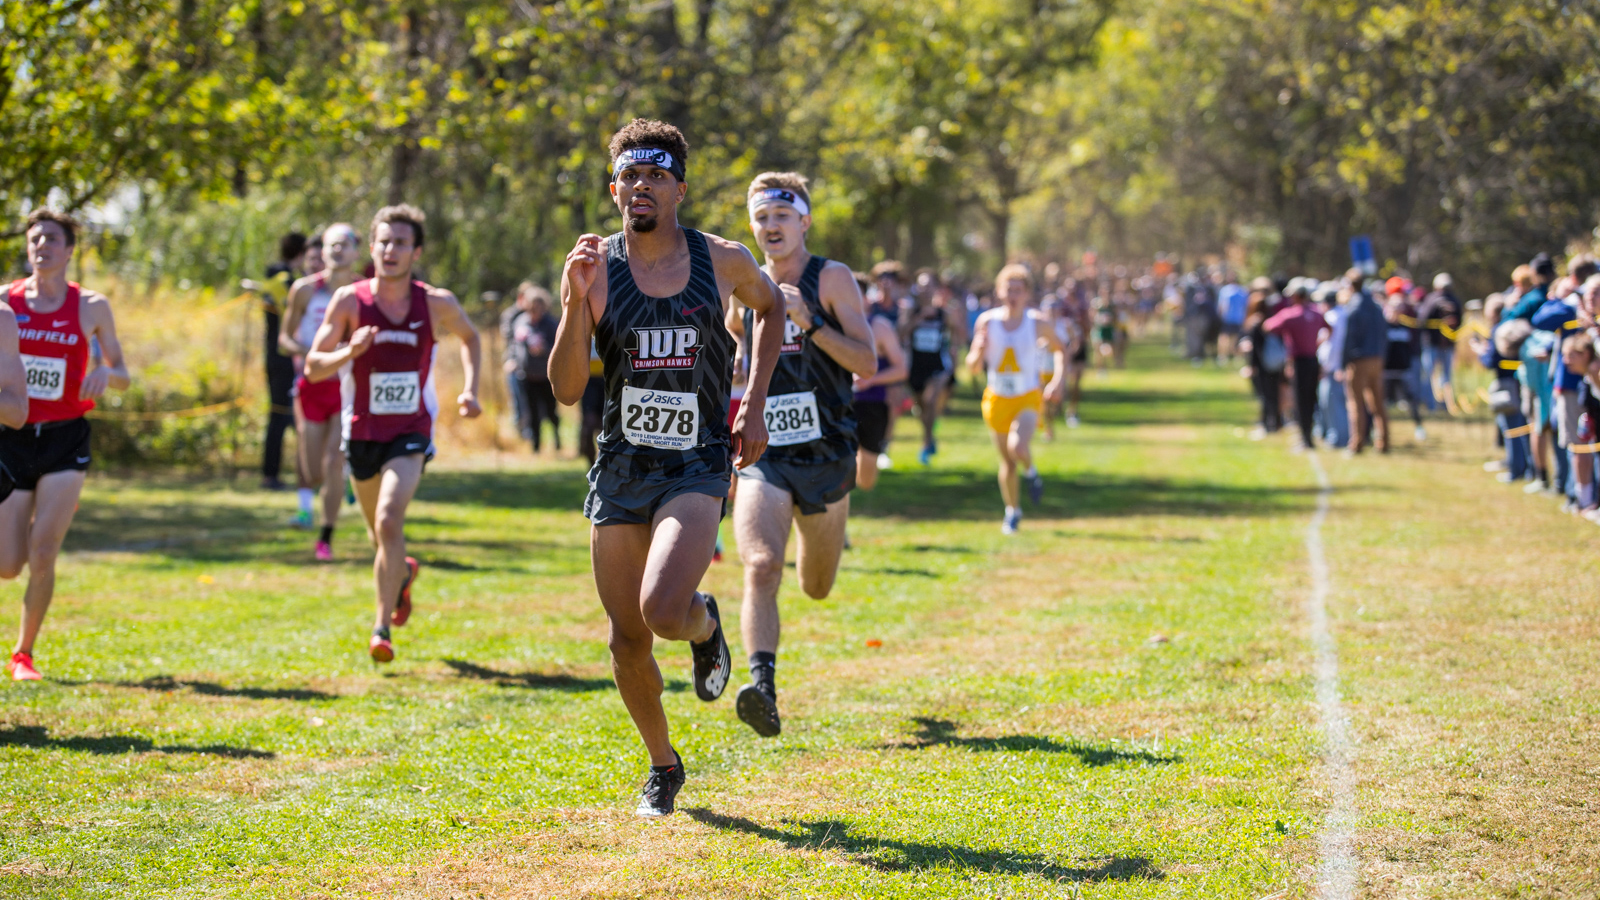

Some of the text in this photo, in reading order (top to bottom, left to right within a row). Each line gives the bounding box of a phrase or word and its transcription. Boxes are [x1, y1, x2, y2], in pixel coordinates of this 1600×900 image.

[632, 149, 654, 159] IUP
[18, 328, 78, 345] IRFIELD
[637, 328, 697, 359] IUP
[634, 358, 692, 368] CRIMSON HAWKS
[26, 369, 60, 388] 863
[374, 385, 416, 401] 2627
[626, 404, 694, 436] 2378
[765, 406, 814, 432] 2384
